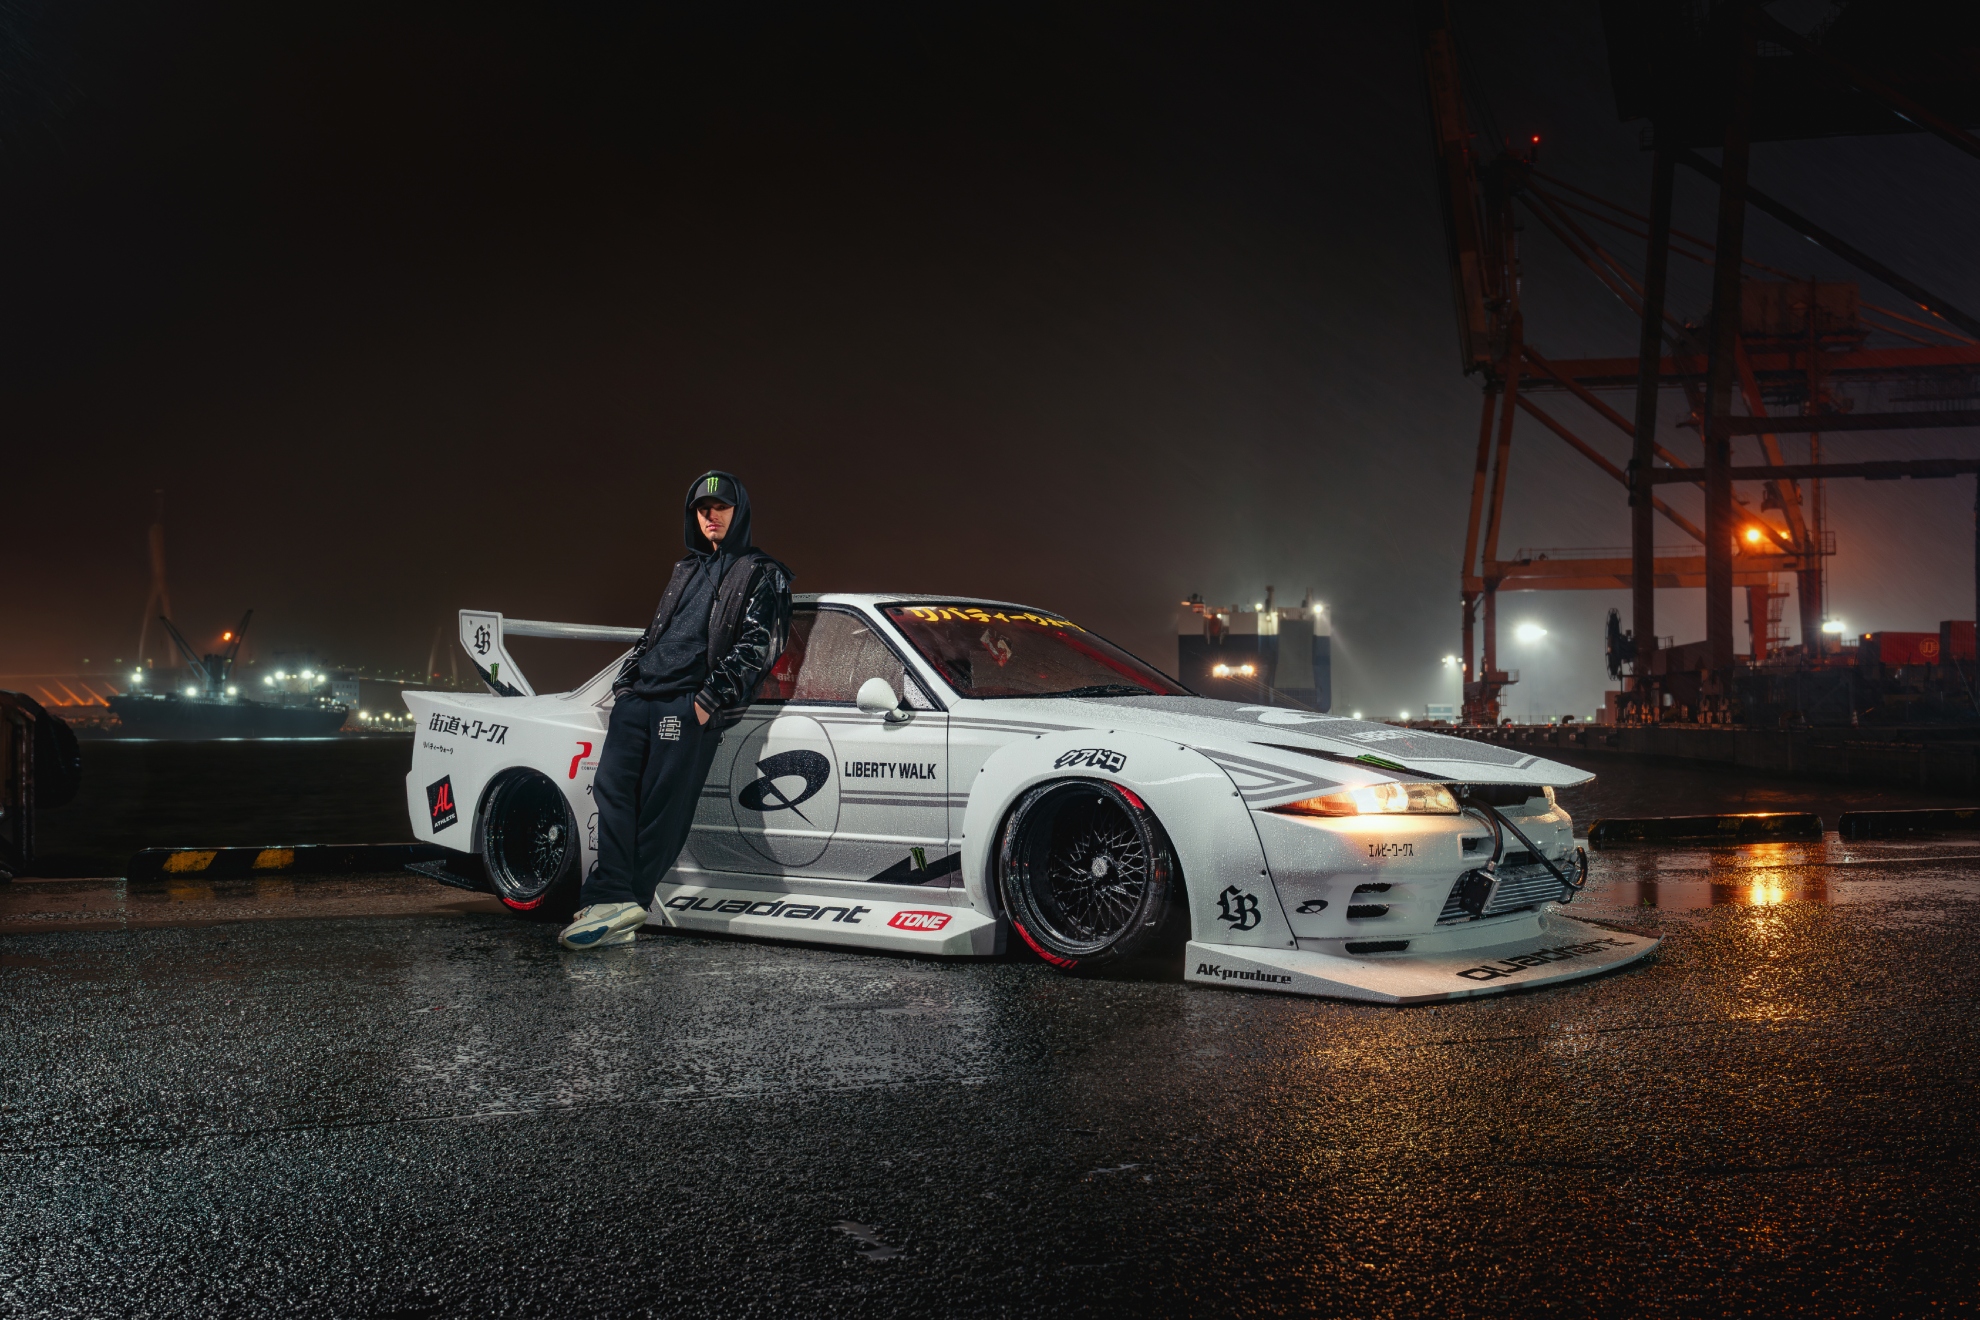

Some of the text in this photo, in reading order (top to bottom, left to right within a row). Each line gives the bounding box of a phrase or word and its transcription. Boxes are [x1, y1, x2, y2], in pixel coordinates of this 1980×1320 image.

[844, 761, 937, 780] LIBERTY WALK
[665, 895, 872, 924] quadrant
[895, 913, 948, 929] TONE
[1196, 963, 1292, 984] AK-produce
